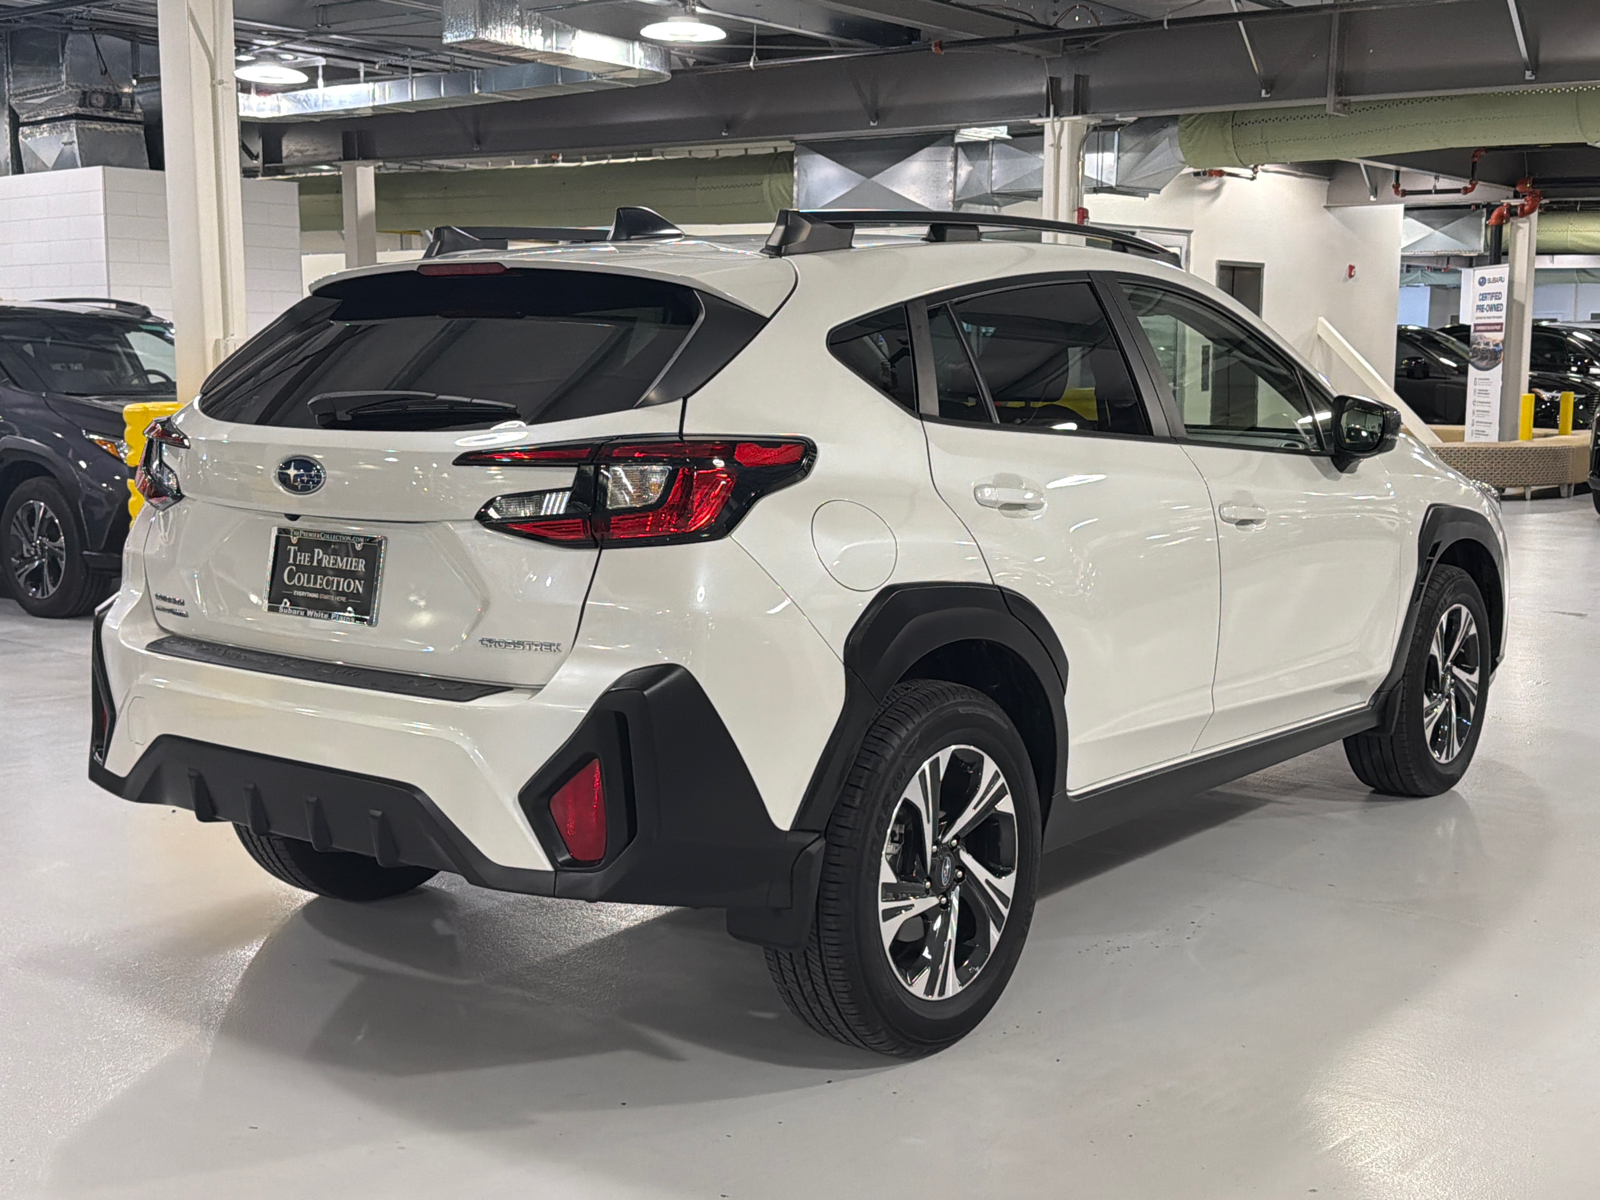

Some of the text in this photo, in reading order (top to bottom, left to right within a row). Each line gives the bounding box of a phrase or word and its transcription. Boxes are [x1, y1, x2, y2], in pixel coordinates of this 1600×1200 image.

[1487, 276, 1505, 284] SUBARU
[1478, 291, 1503, 301] CERTIFIED
[1476, 303, 1504, 313] PRE-OWNED
[287, 545, 366, 572] THE PREMIER
[283, 566, 364, 594] COLLECTION
[293, 590, 319, 599] EVERYTHING
[279, 606, 305, 616] Subaru
[306, 610, 329, 619] White
[479, 638, 562, 652] CROSSTREK
